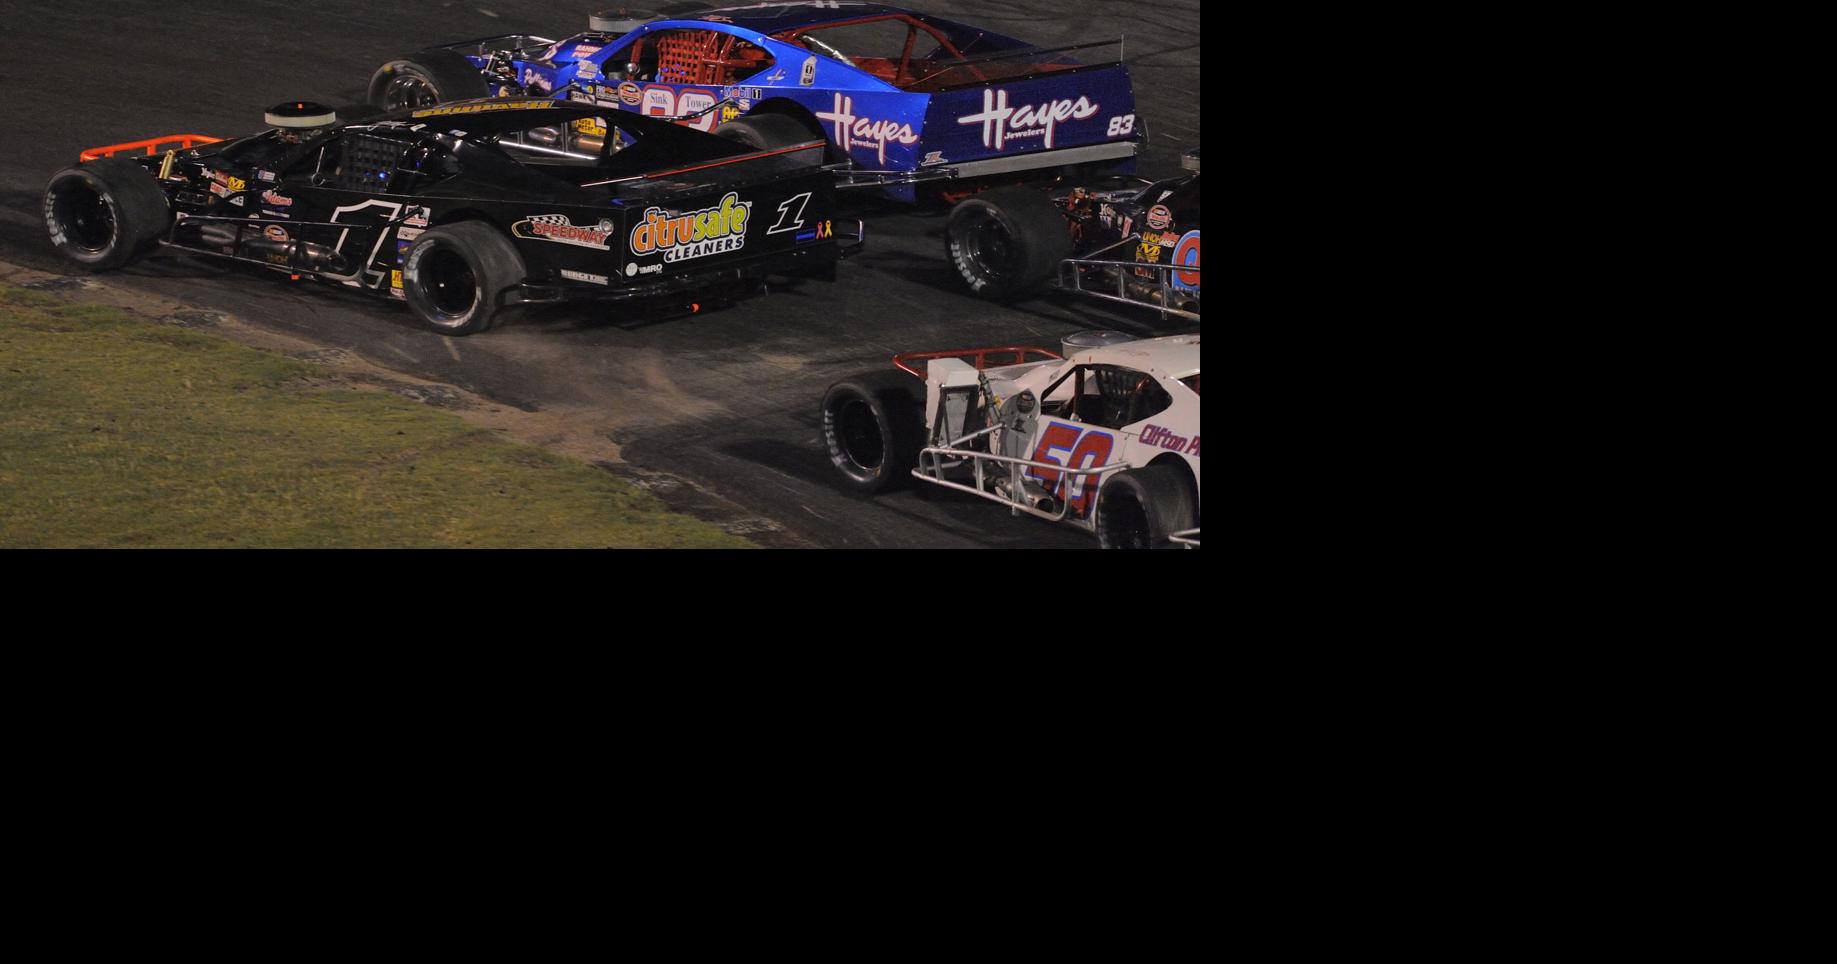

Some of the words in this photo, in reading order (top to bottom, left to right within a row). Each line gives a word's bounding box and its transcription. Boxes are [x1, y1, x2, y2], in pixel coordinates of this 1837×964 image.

[650, 92, 668, 105] Sink
[684, 95, 712, 109] Tower
[723, 85, 752, 99] Mobil
[816, 92, 918, 166] Hayes
[957, 88, 1099, 150] Hayes
[1107, 114, 1136, 137] 83
[850, 138, 879, 149] Jewelers
[1004, 128, 1046, 140] Jewelers
[631, 193, 750, 256] citrusafe
[766, 192, 812, 235] 1
[330, 199, 403, 289] 1
[533, 222, 606, 245] SPEEDWAY
[664, 234, 744, 263] CLEANERS
[1139, 423, 1188, 452] Clifton
[1024, 420, 1114, 520] 50
